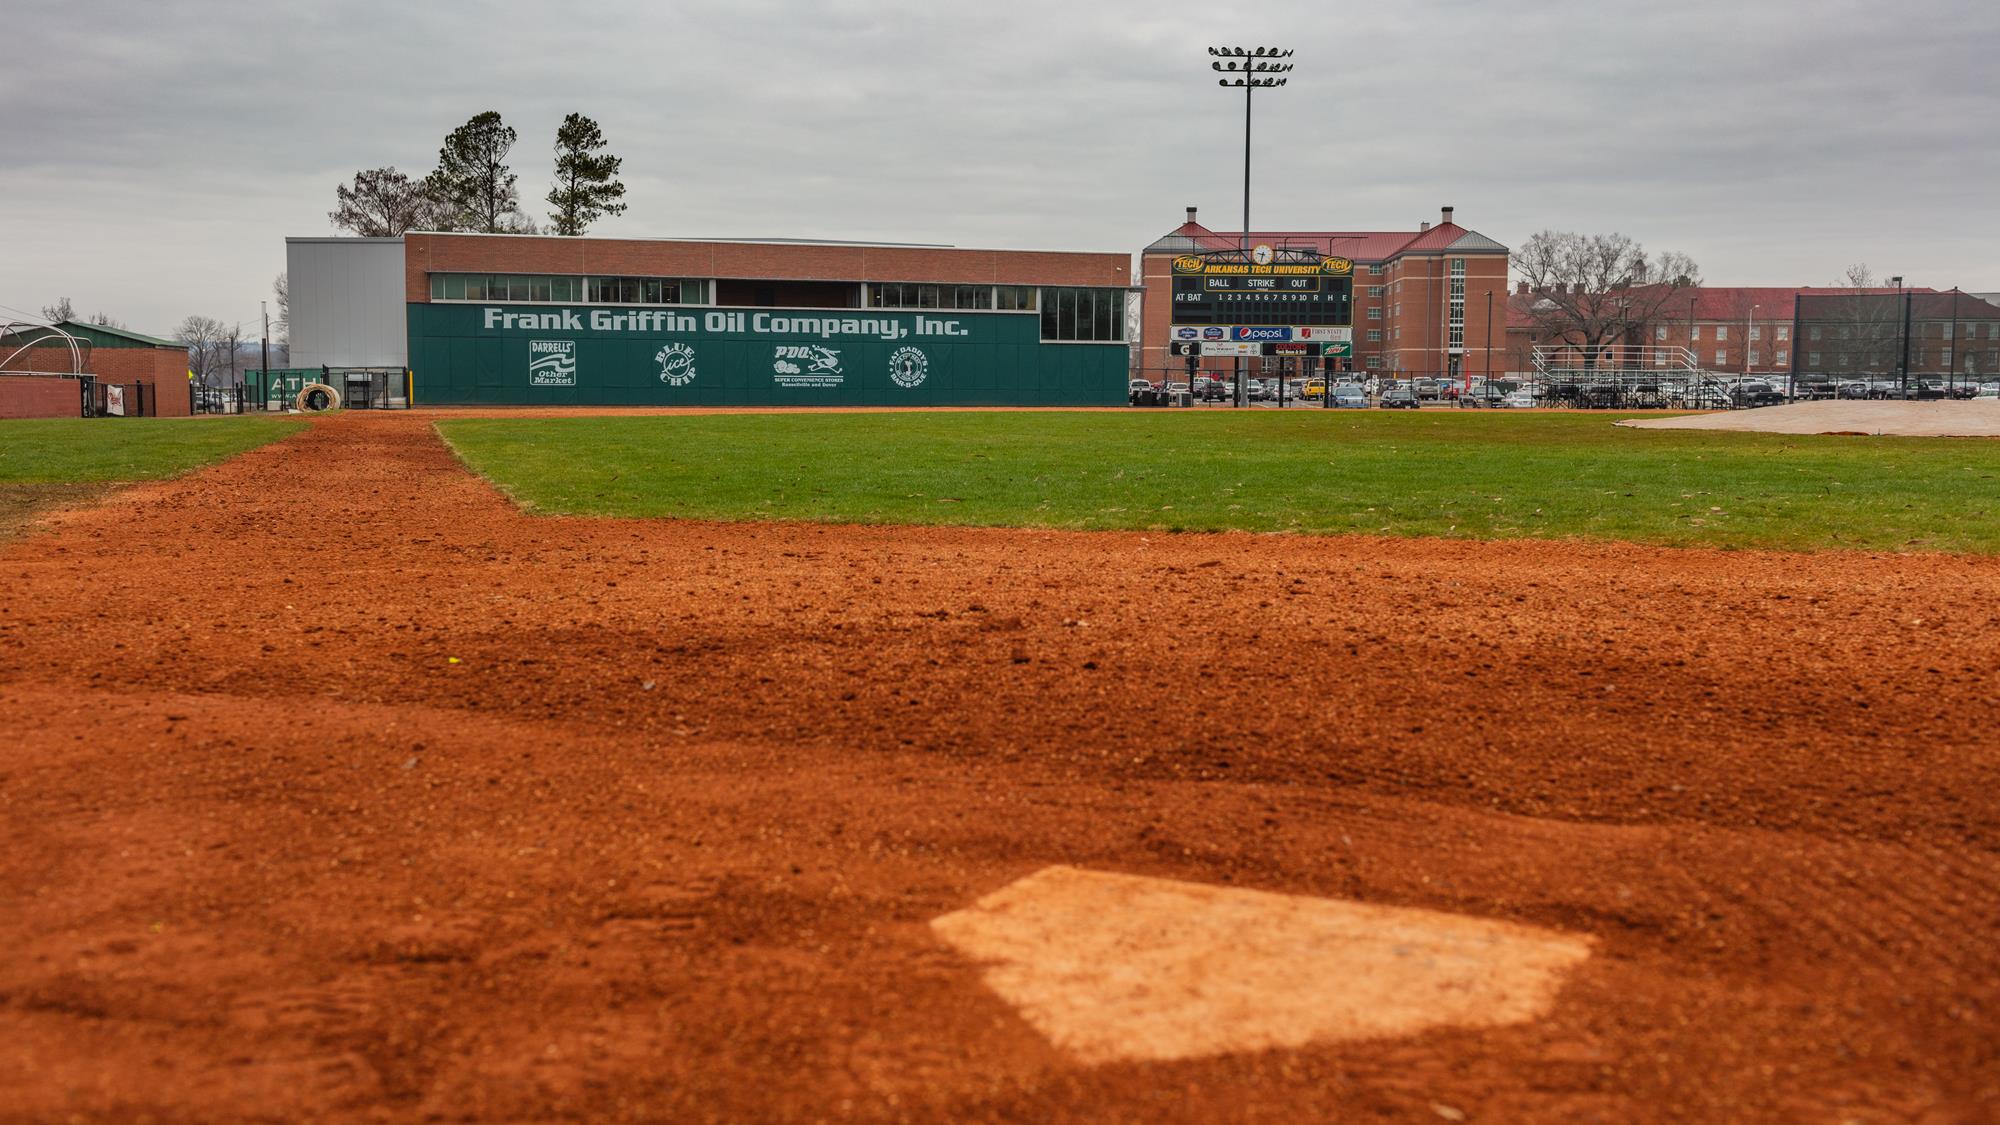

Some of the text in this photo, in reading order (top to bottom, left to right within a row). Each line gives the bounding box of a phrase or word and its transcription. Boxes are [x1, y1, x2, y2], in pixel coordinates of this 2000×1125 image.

[1178, 259, 1200, 269] TECH
[1204, 264, 1321, 274] ARKANSAS TECH UNIVERSITY
[1326, 260, 1349, 270] TECH
[1209, 279, 1230, 287] BALL
[1247, 279, 1275, 287] STRIKE
[1291, 280, 1307, 288] OUT
[1175, 293, 1202, 301] AT BAT
[484, 307, 968, 340] Frank Griffin Oil Company, Inc.
[1252, 329, 1283, 339] pepsi
[532, 342, 574, 353] DARRELLS'
[655, 342, 695, 363] BLUE
[774, 346, 810, 359] PDQ
[1180, 344, 1190, 355] G
[889, 350, 899, 366] FAT
[660, 367, 696, 386] CHIP
